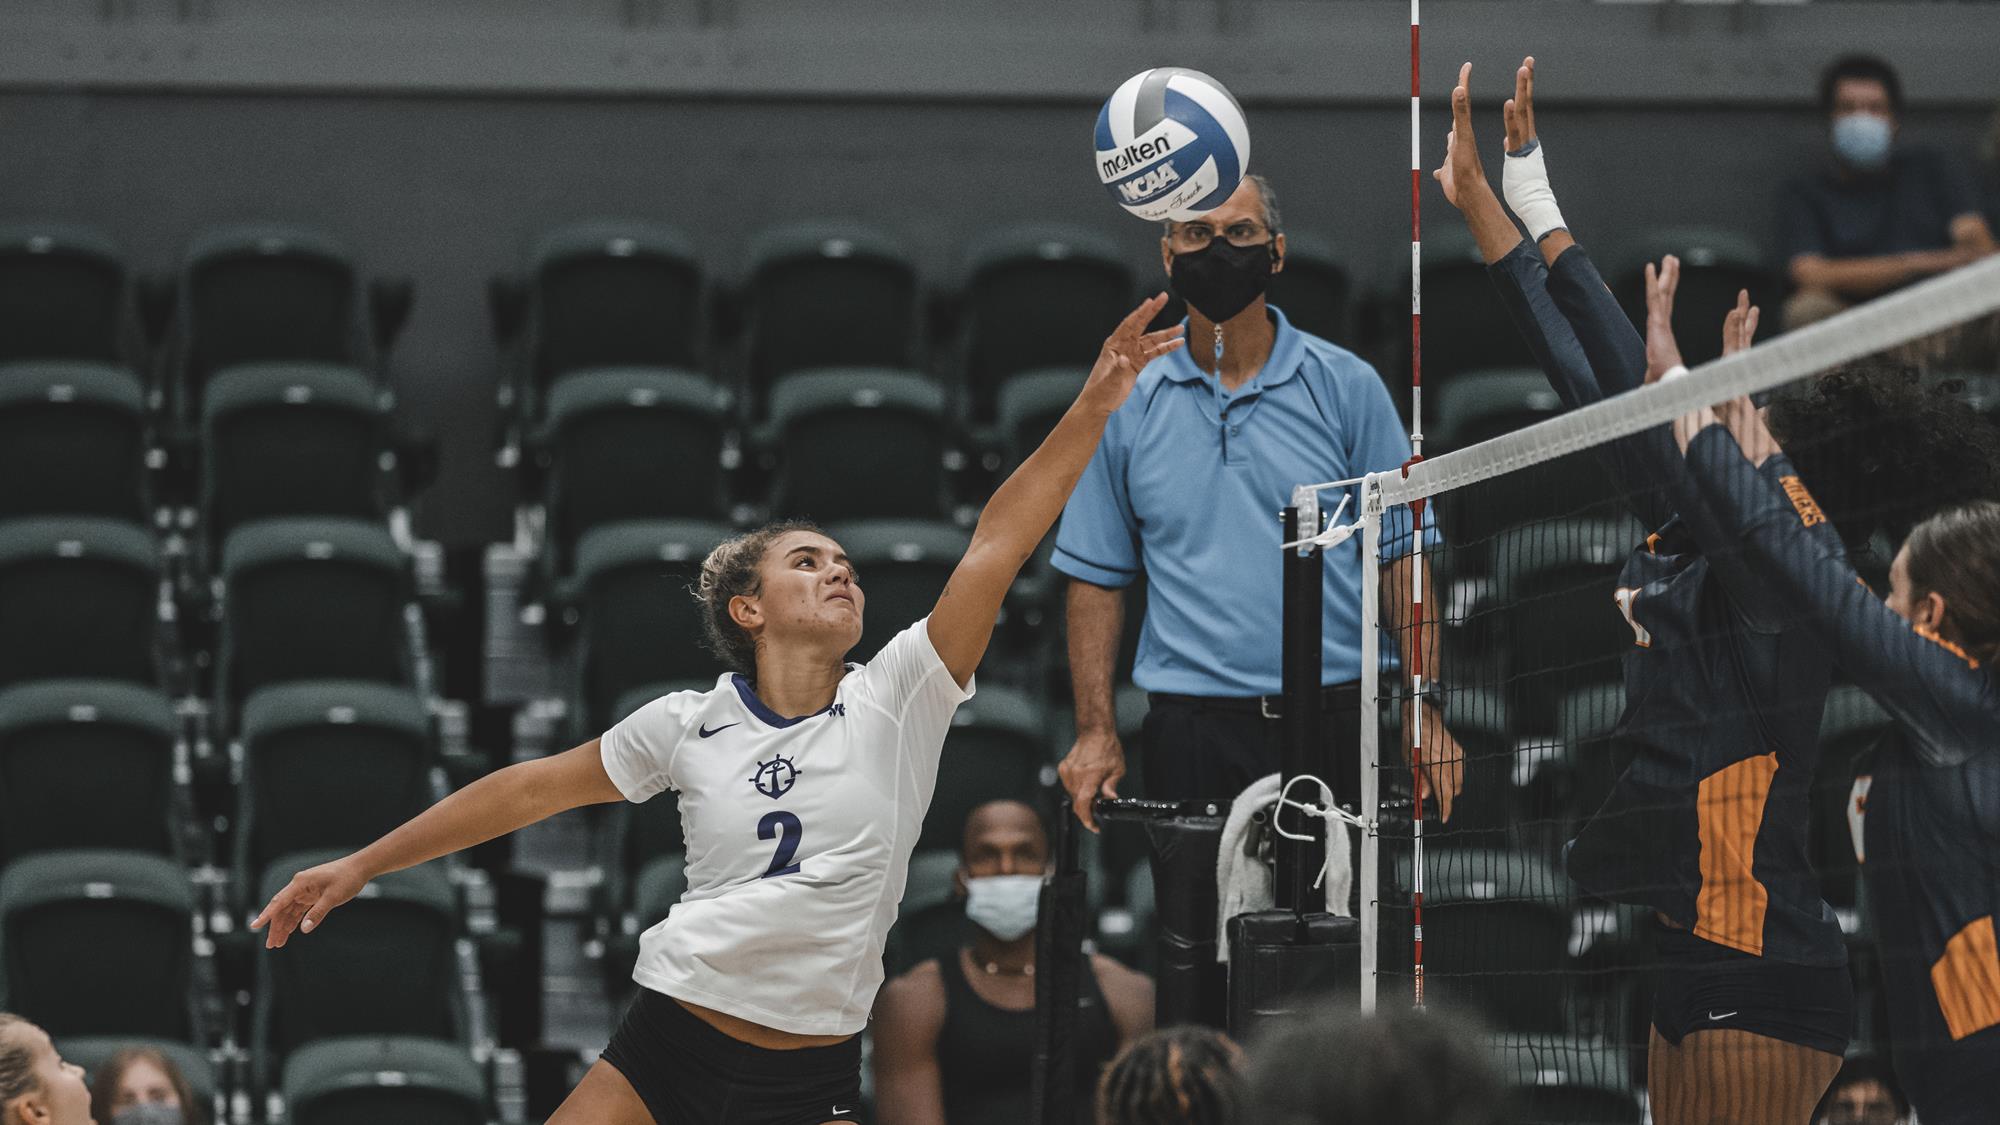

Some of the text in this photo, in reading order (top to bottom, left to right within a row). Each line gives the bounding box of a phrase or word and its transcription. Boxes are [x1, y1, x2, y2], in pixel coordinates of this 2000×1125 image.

[1102, 136, 1171, 179] molten
[1118, 163, 1180, 202] NCAA
[757, 810, 802, 879] 2
